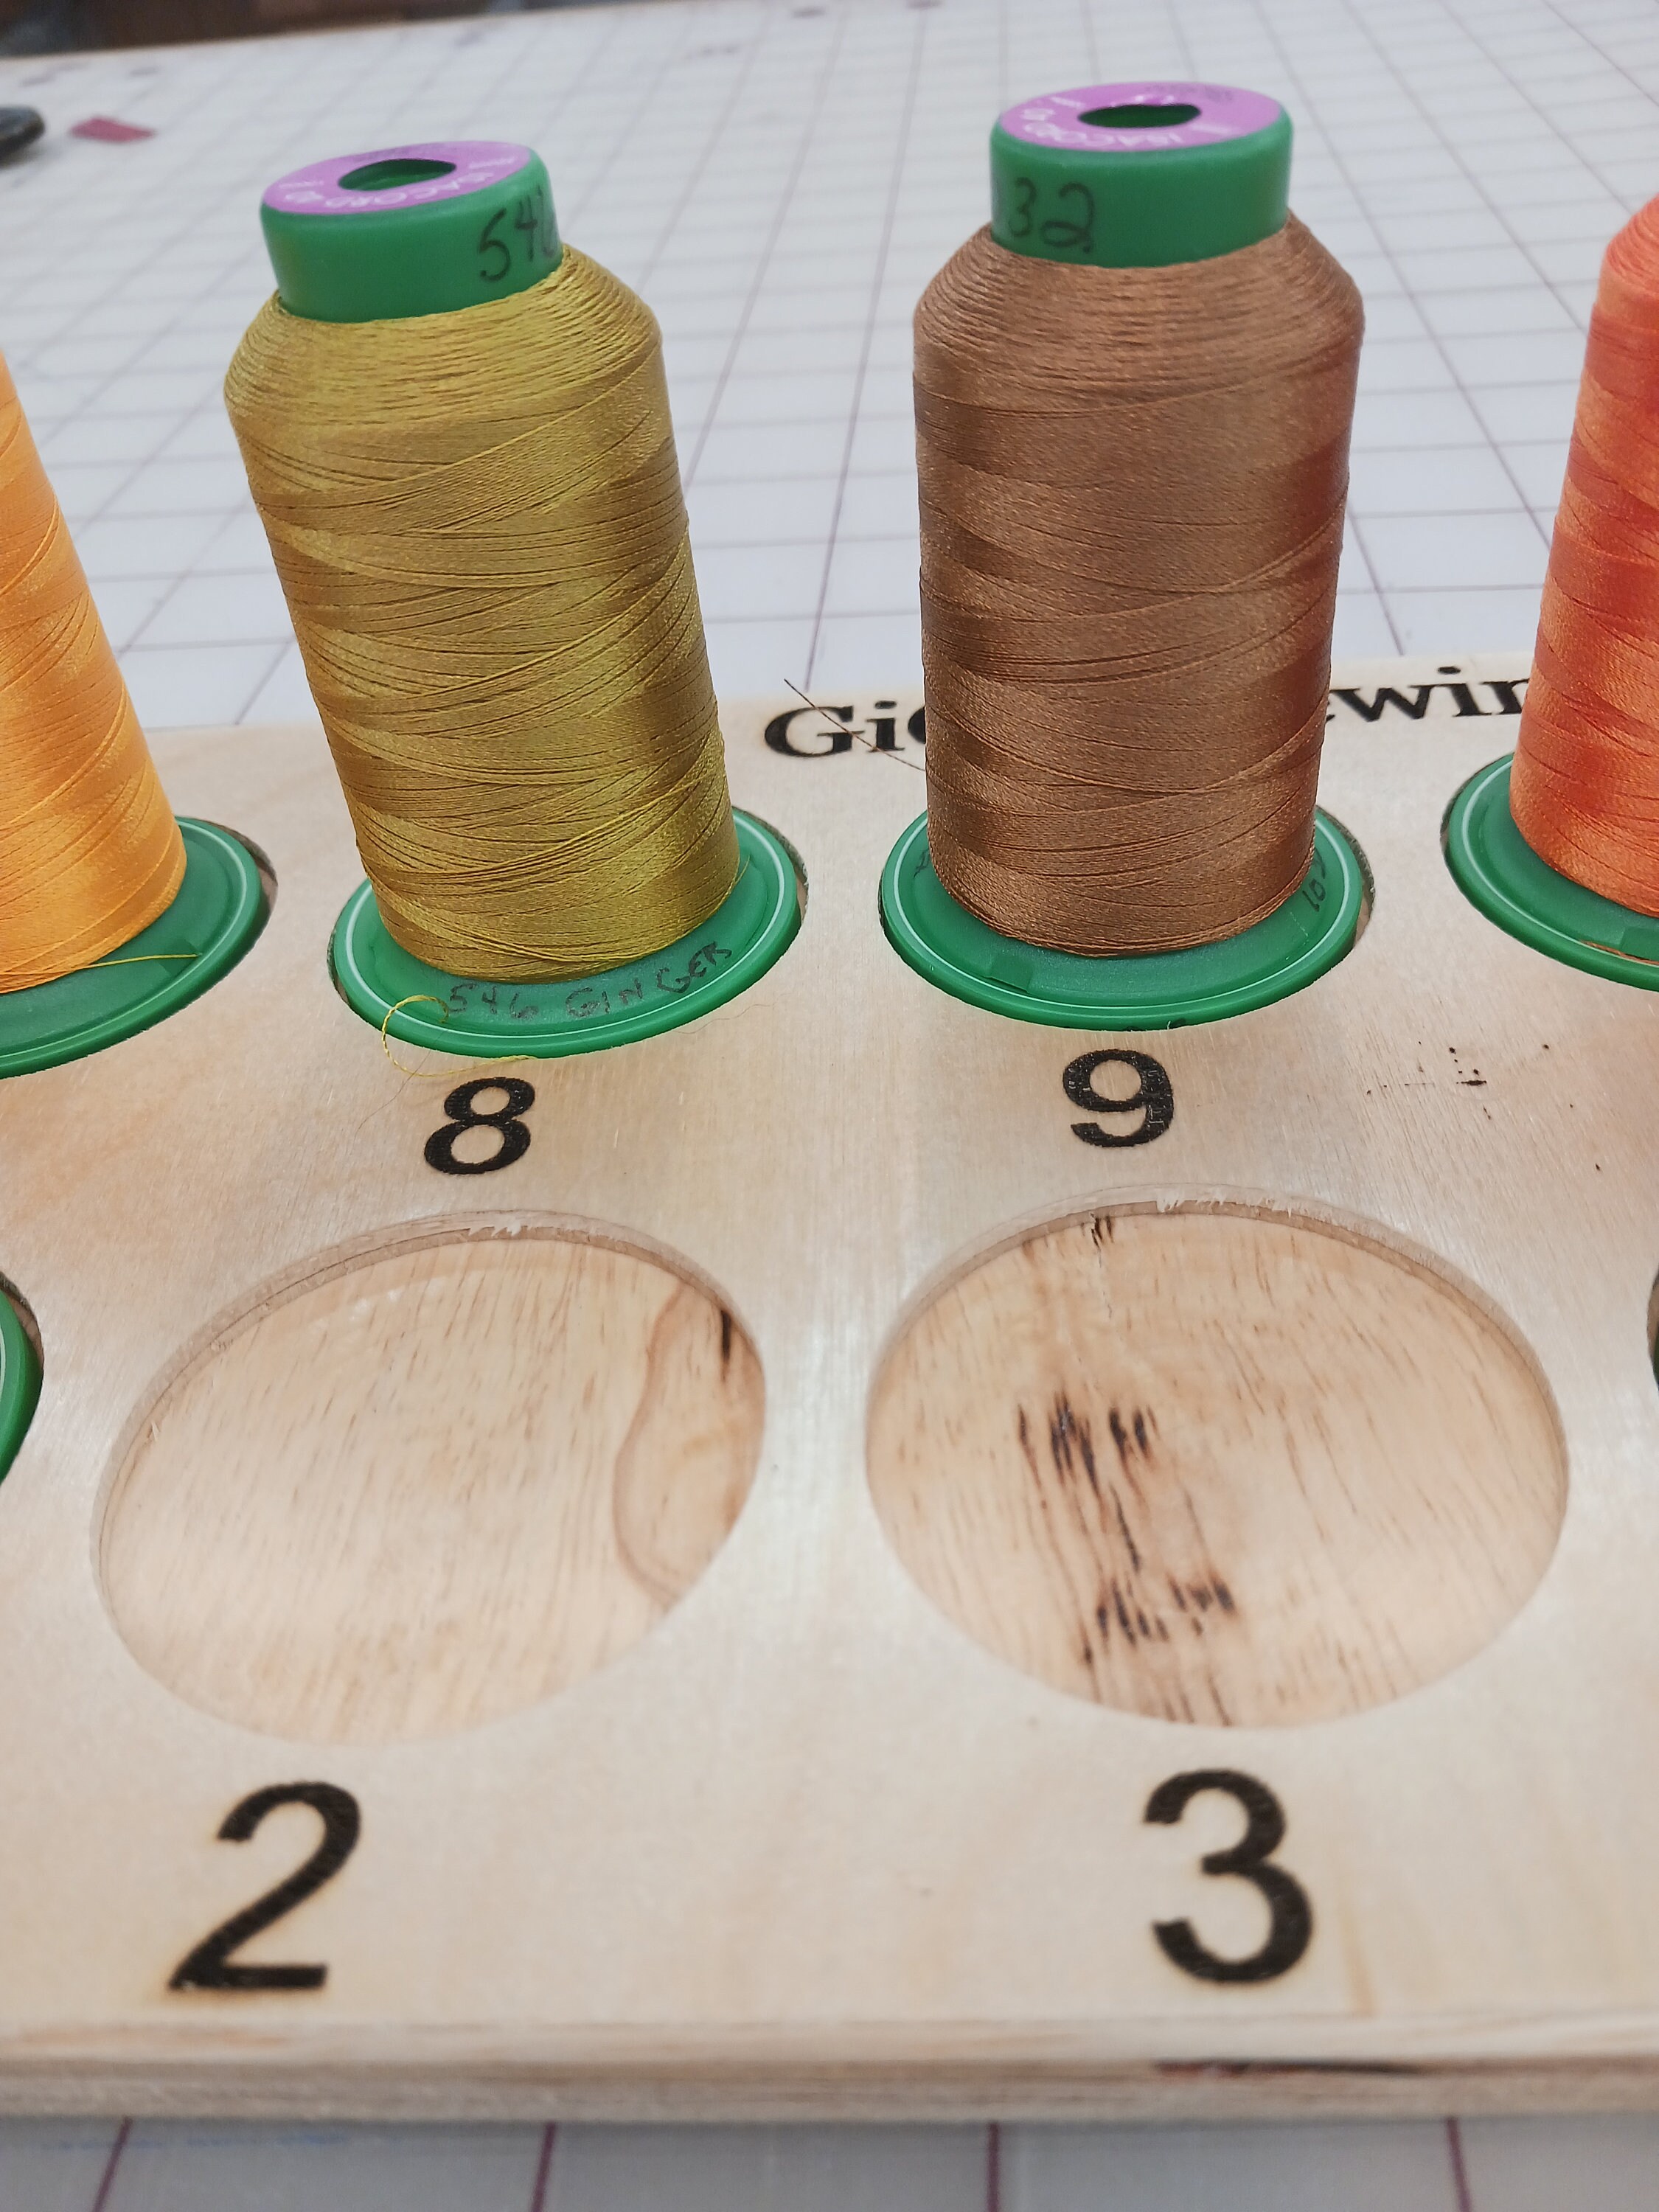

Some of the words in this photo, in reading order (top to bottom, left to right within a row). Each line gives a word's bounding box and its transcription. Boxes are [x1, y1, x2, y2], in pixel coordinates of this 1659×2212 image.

[448, 983, 538, 1019] 546
[565, 941, 732, 1018] GINGER
[424, 1077, 535, 1175] 8
[1062, 1048, 1174, 1147] 9
[169, 1781, 361, 1989] 2
[1144, 1769, 1313, 1983] 3
